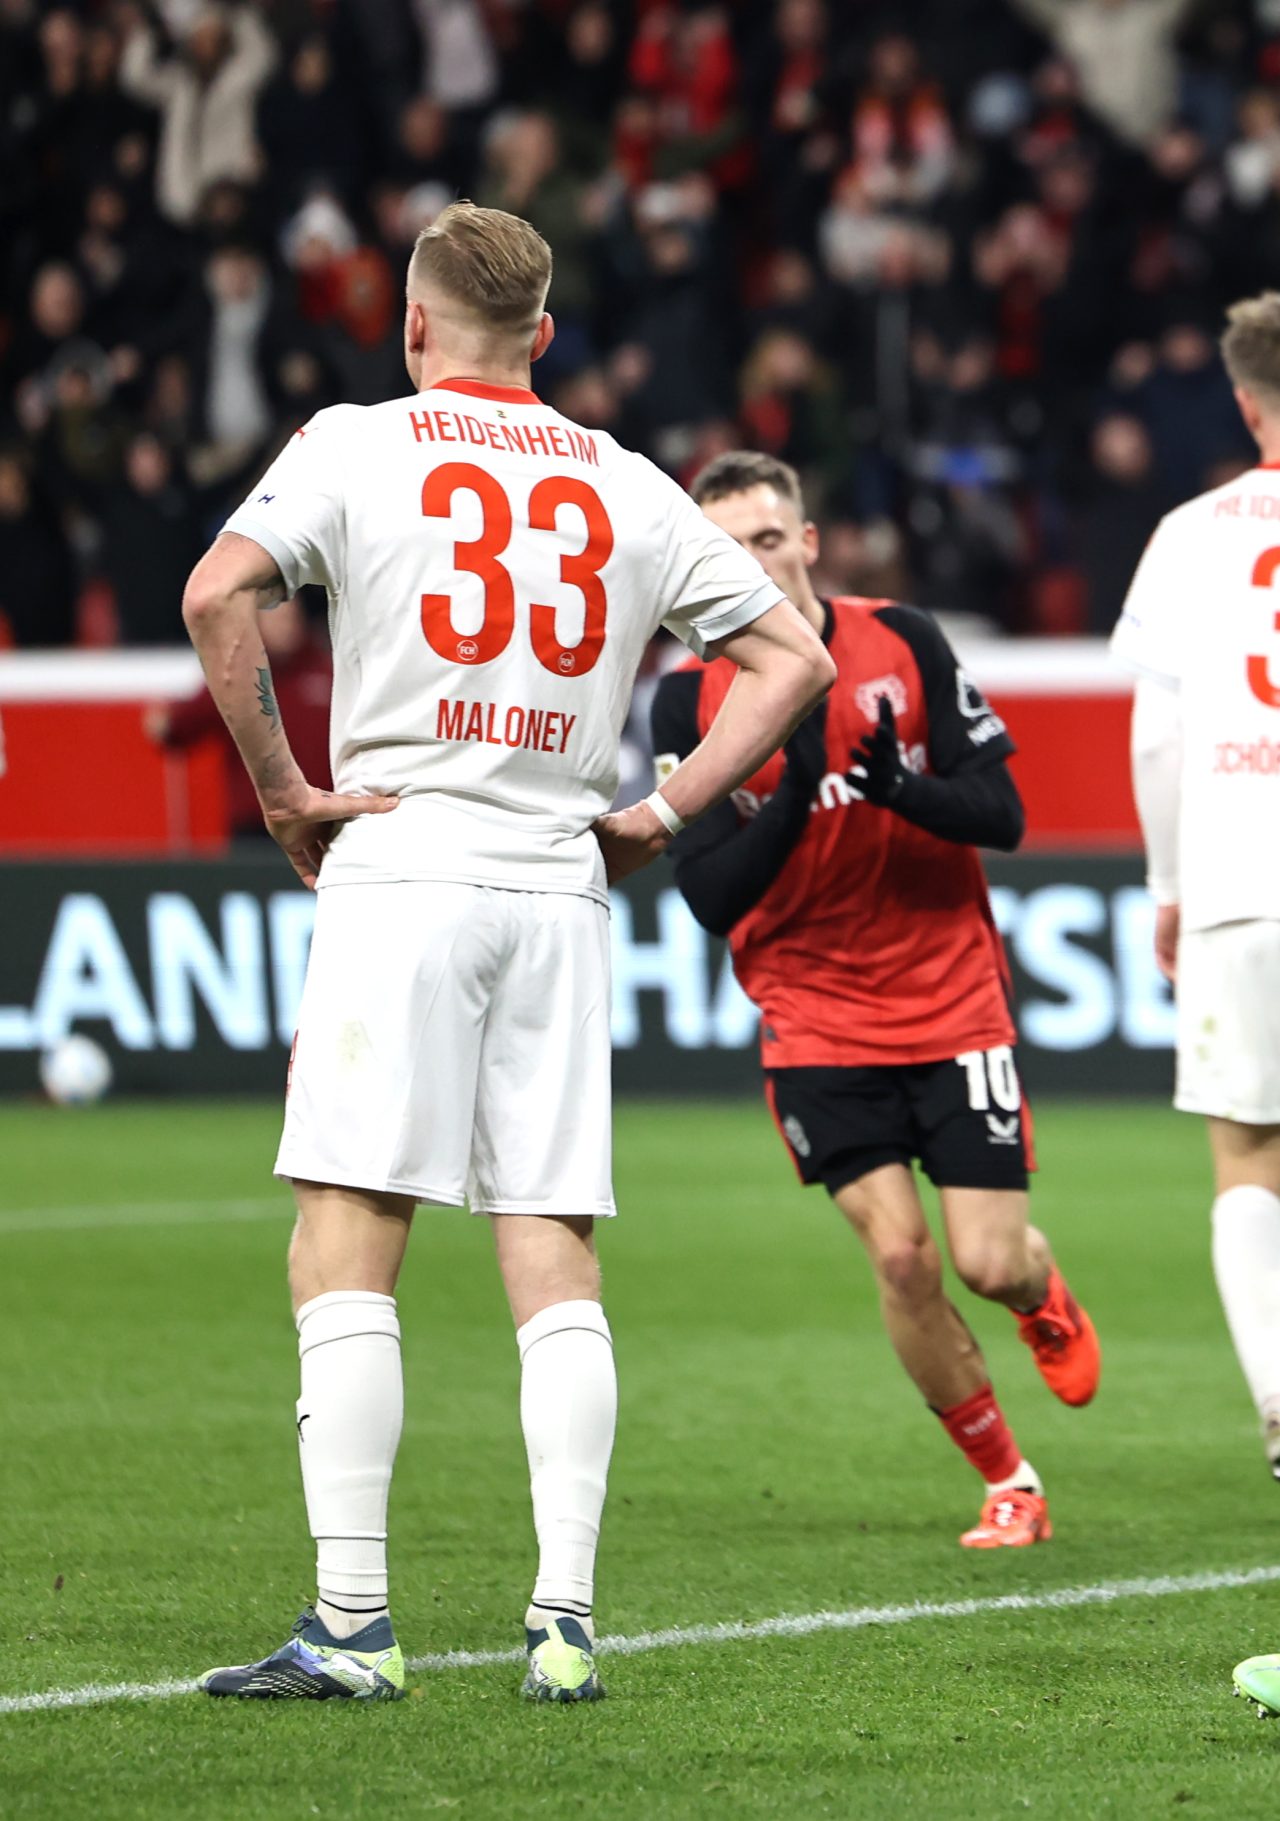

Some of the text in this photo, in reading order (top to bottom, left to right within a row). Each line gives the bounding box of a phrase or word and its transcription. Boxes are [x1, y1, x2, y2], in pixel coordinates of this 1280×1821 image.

[409, 411, 600, 467] HEIDENHEIM
[421, 462, 614, 677] 33
[436, 698, 577, 754] MALONEY
[955, 1044, 1021, 1112] 10
